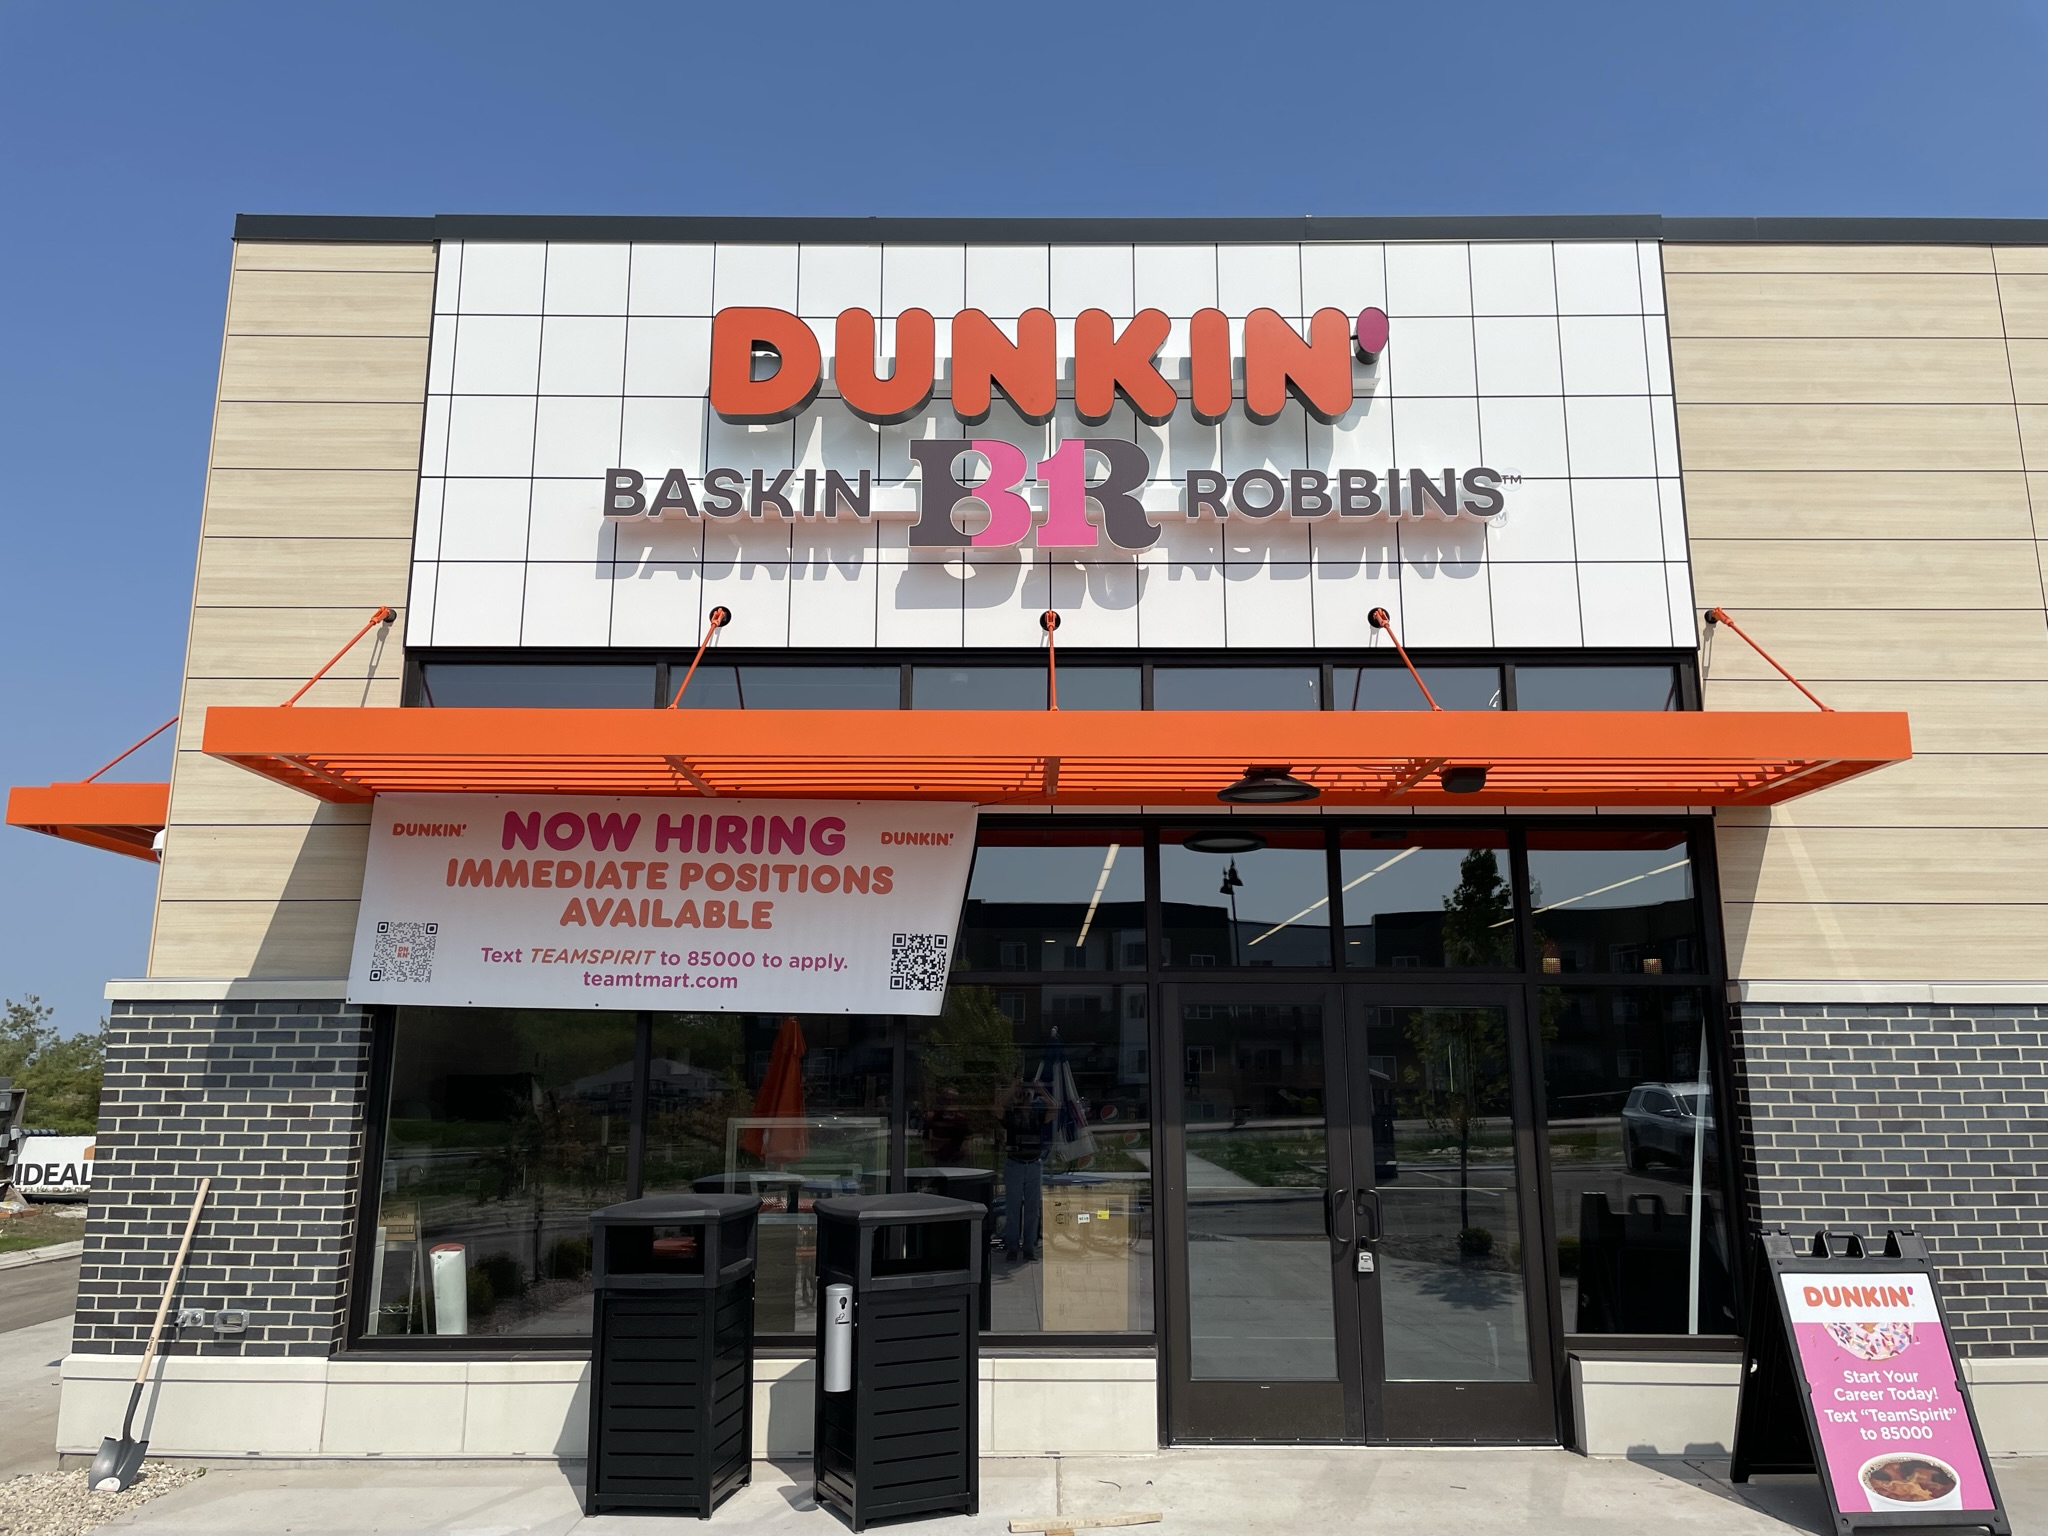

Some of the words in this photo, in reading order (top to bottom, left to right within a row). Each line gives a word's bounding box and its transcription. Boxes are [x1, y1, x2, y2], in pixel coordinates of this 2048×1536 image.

[709, 306, 1389, 424] DUNKIN'
[603, 467, 872, 520] BASKIN
[1185, 467, 1505, 519] ROBBINS
[392, 822, 467, 837] DUNKIN'
[501, 811, 641, 851] NOW
[655, 813, 846, 856] HIRING
[881, 831, 954, 846] DUNKIN'
[446, 858, 669, 890] IMMEDIATE
[680, 862, 894, 895] POSITIONS
[560, 897, 774, 930] AVAILABLE
[481, 947, 522, 964] Text
[530, 948, 656, 965] TEAMSPIRIT
[660, 950, 680, 967] to
[687, 951, 755, 967] 85000
[762, 953, 782, 968] to
[788, 953, 849, 972] apply.
[583, 971, 738, 989] teamtmart.com
[14, 1163, 92, 1186] IDEAL
[1803, 1286, 1914, 1307] DUNKIN'
[1843, 1370, 1881, 1383] Start
[1882, 1370, 1918, 1383] Your
[1834, 1388, 1884, 1401] Career
[1886, 1387, 1939, 1402] Today!
[1824, 1409, 1858, 1422] Text
[1860, 1428, 1877, 1440] to
[1880, 1426, 1933, 1440] 85000
